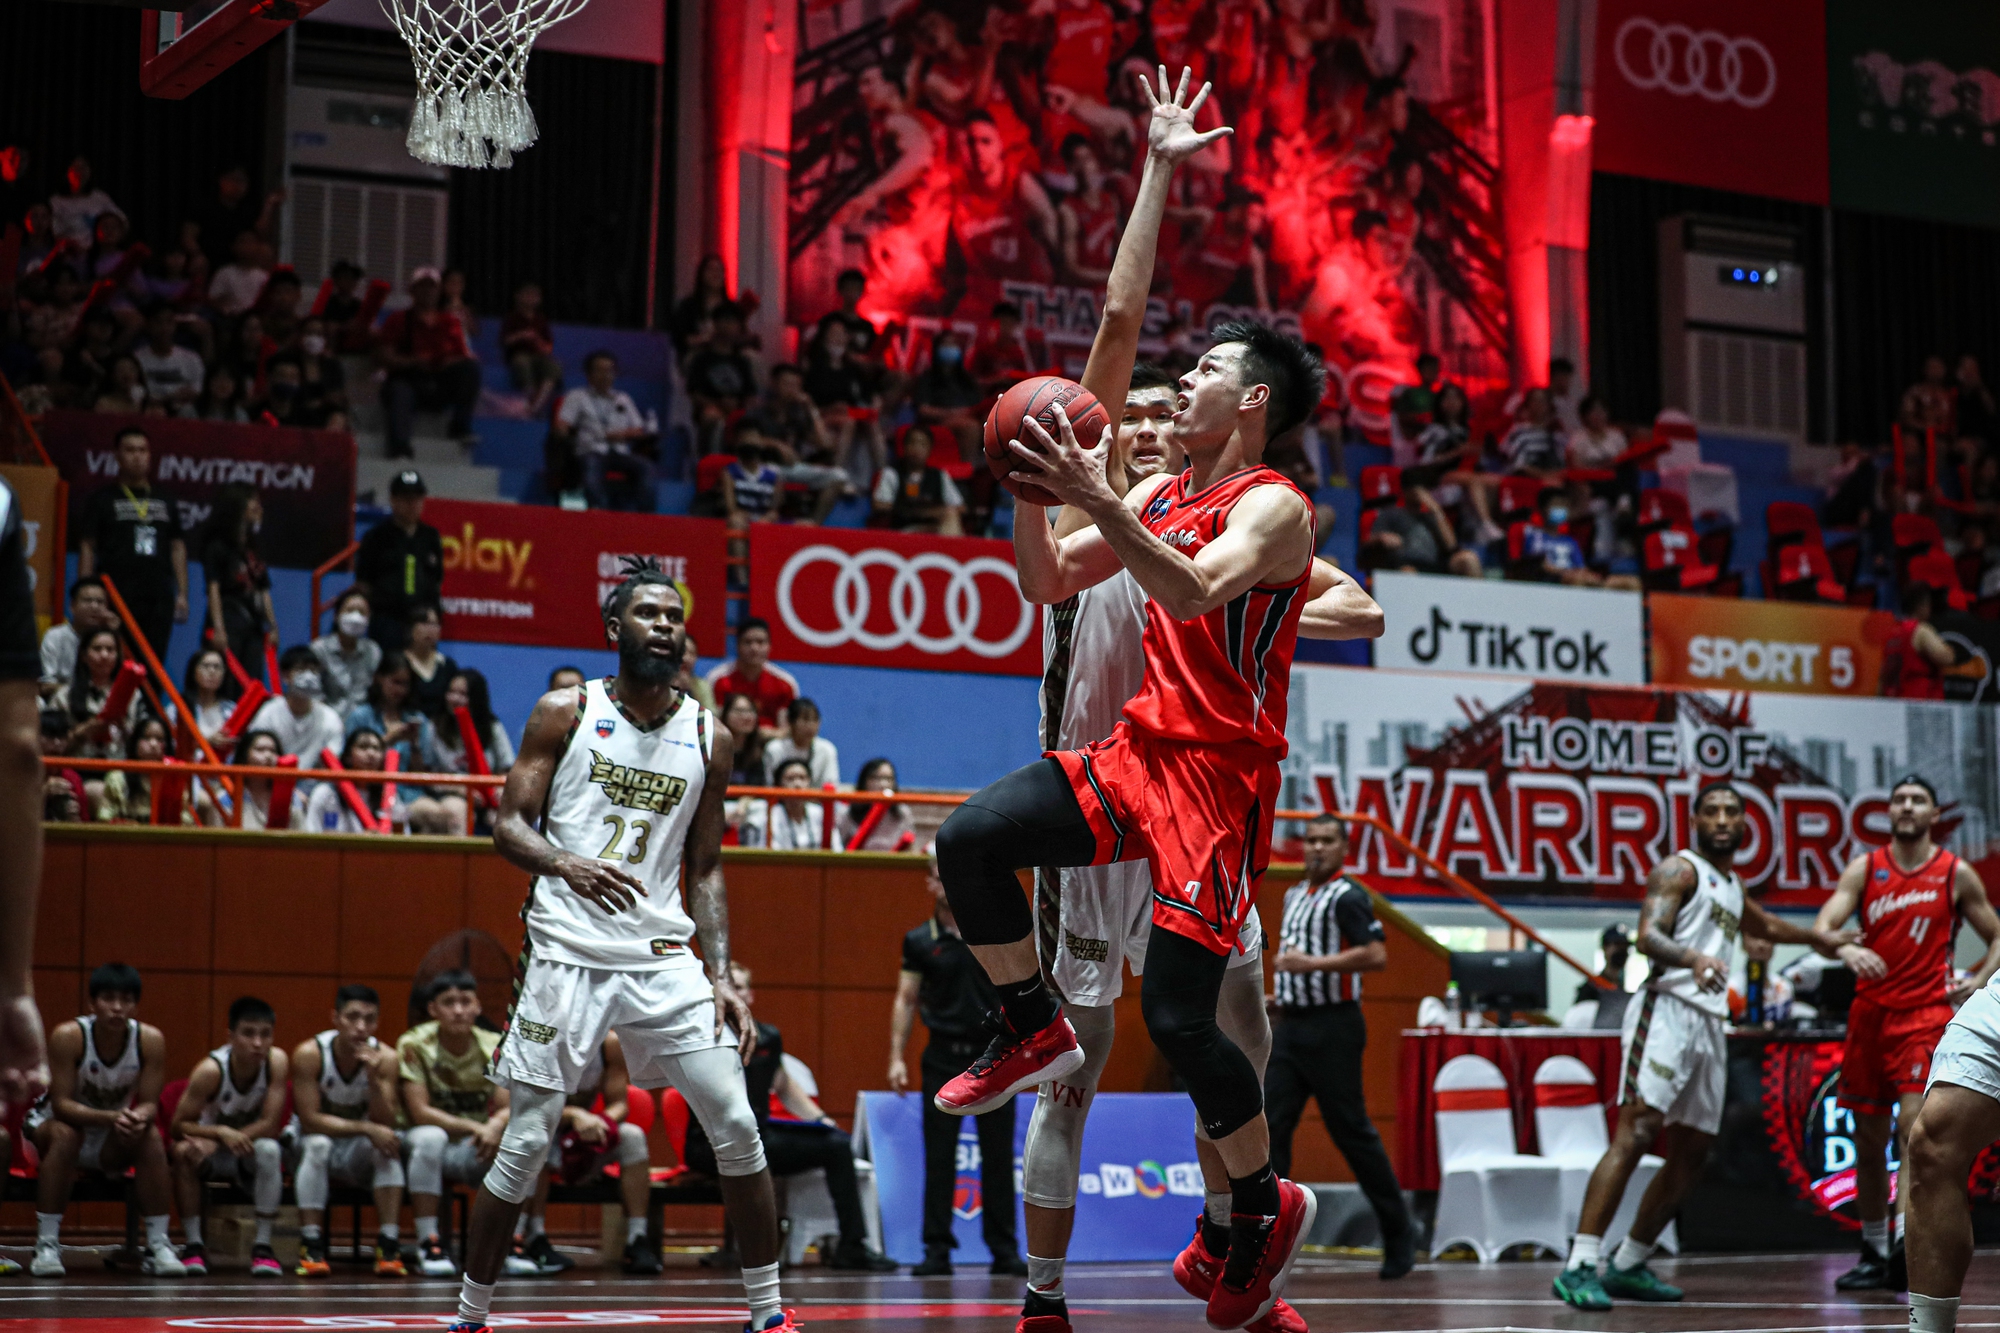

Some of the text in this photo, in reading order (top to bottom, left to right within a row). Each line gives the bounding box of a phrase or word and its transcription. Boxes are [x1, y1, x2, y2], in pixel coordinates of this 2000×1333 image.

[1002, 279, 1171, 340] THAG
[440, 596, 534, 618] UTRITION
[1460, 622, 1610, 676] TikTok
[1688, 635, 1855, 688] SPORT 5
[1502, 714, 1769, 778] HOME OF
[588, 762, 688, 799] SAIGON
[611, 785, 681, 817] HEAT
[597, 814, 652, 865] 23
[1908, 916, 1931, 945] 4
[1051, 1080, 1087, 1109] VN
